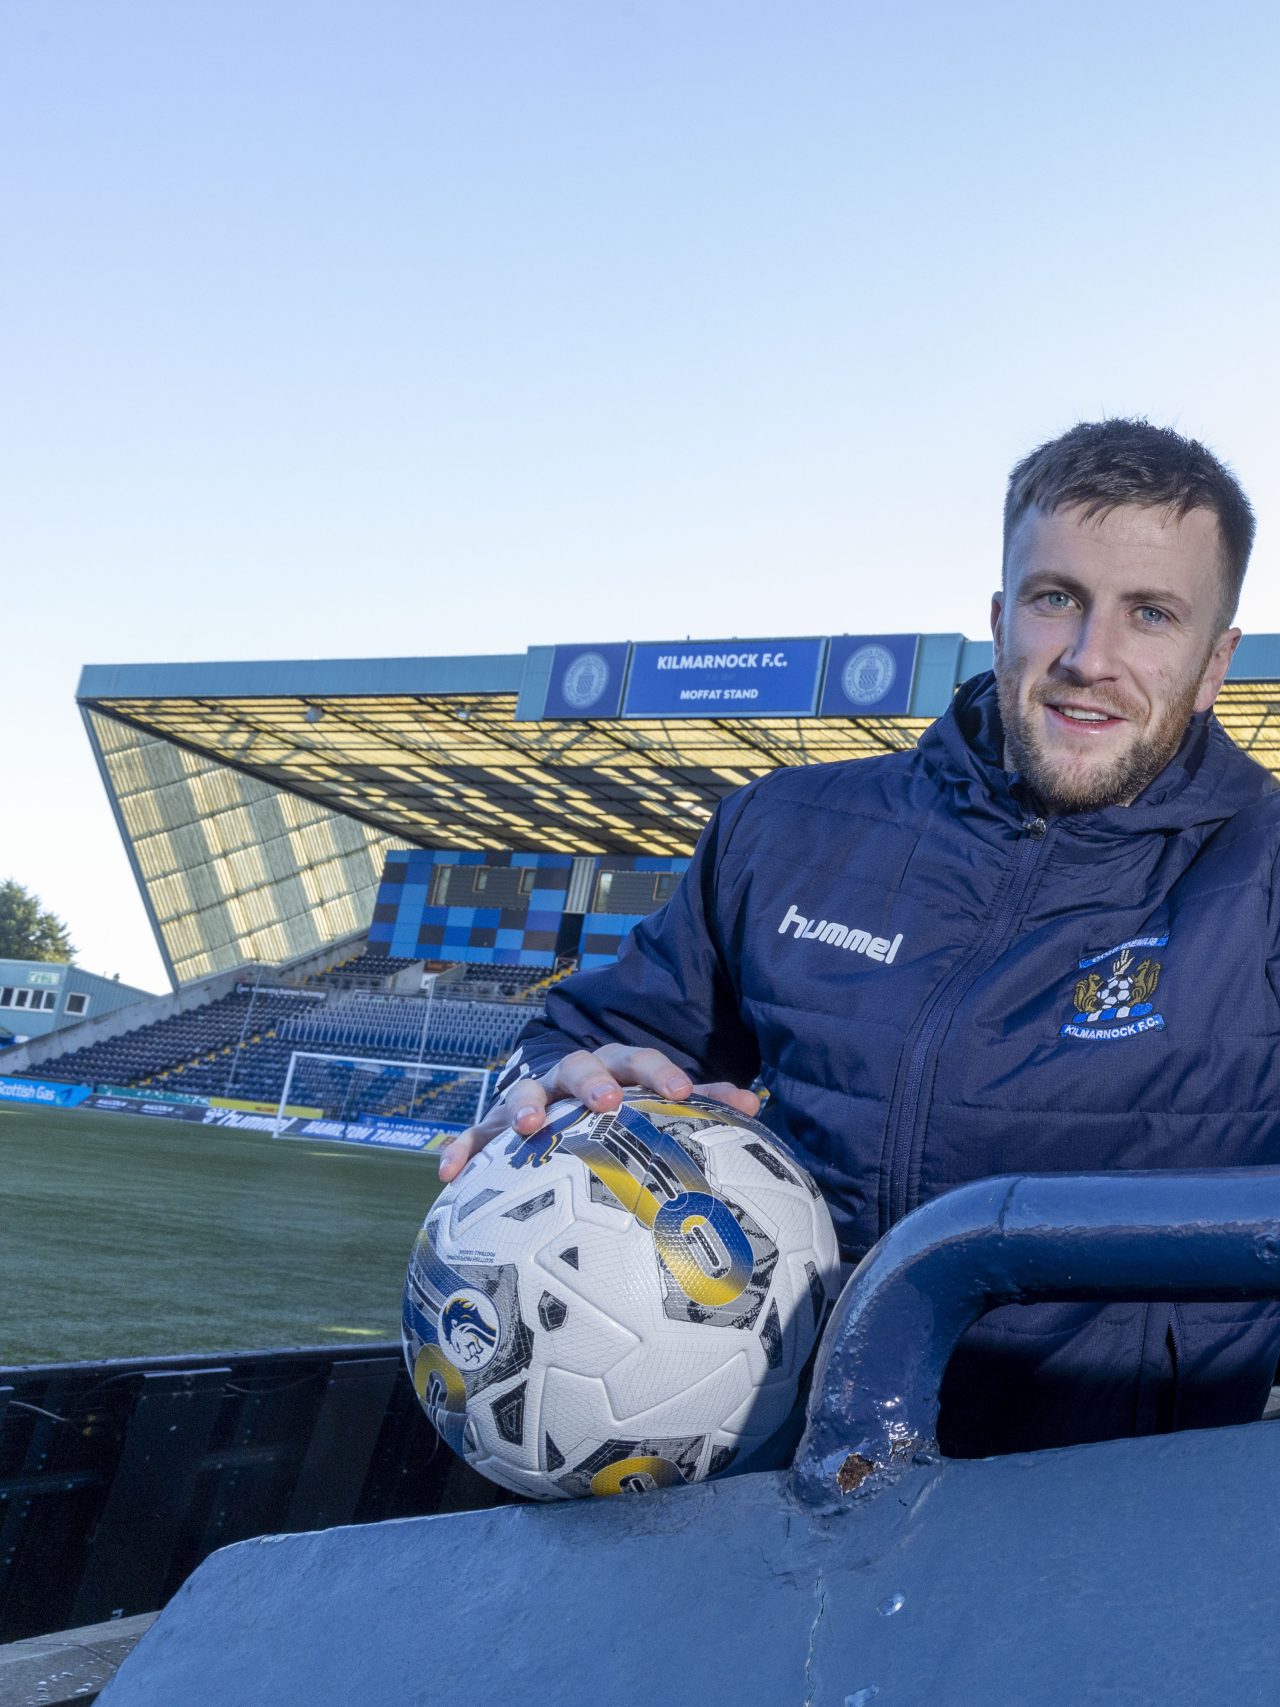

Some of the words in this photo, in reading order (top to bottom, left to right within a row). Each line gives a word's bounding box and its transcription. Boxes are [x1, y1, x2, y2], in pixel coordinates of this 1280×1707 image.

[657, 654, 758, 670] KILMARNOCK
[761, 653, 788, 668] F.C.
[680, 690, 721, 700] MOFFAT
[723, 689, 759, 699] STAND
[778, 904, 904, 965] hummel
[1065, 1024, 1136, 1039] KILMARNOCK
[1138, 1017, 1159, 1032] F.C.
[36, 1086, 55, 1101] Gas
[217, 1110, 298, 1133] hummel
[301, 1121, 373, 1140] HAMILTON
[369, 1129, 432, 1147] TARMAC
